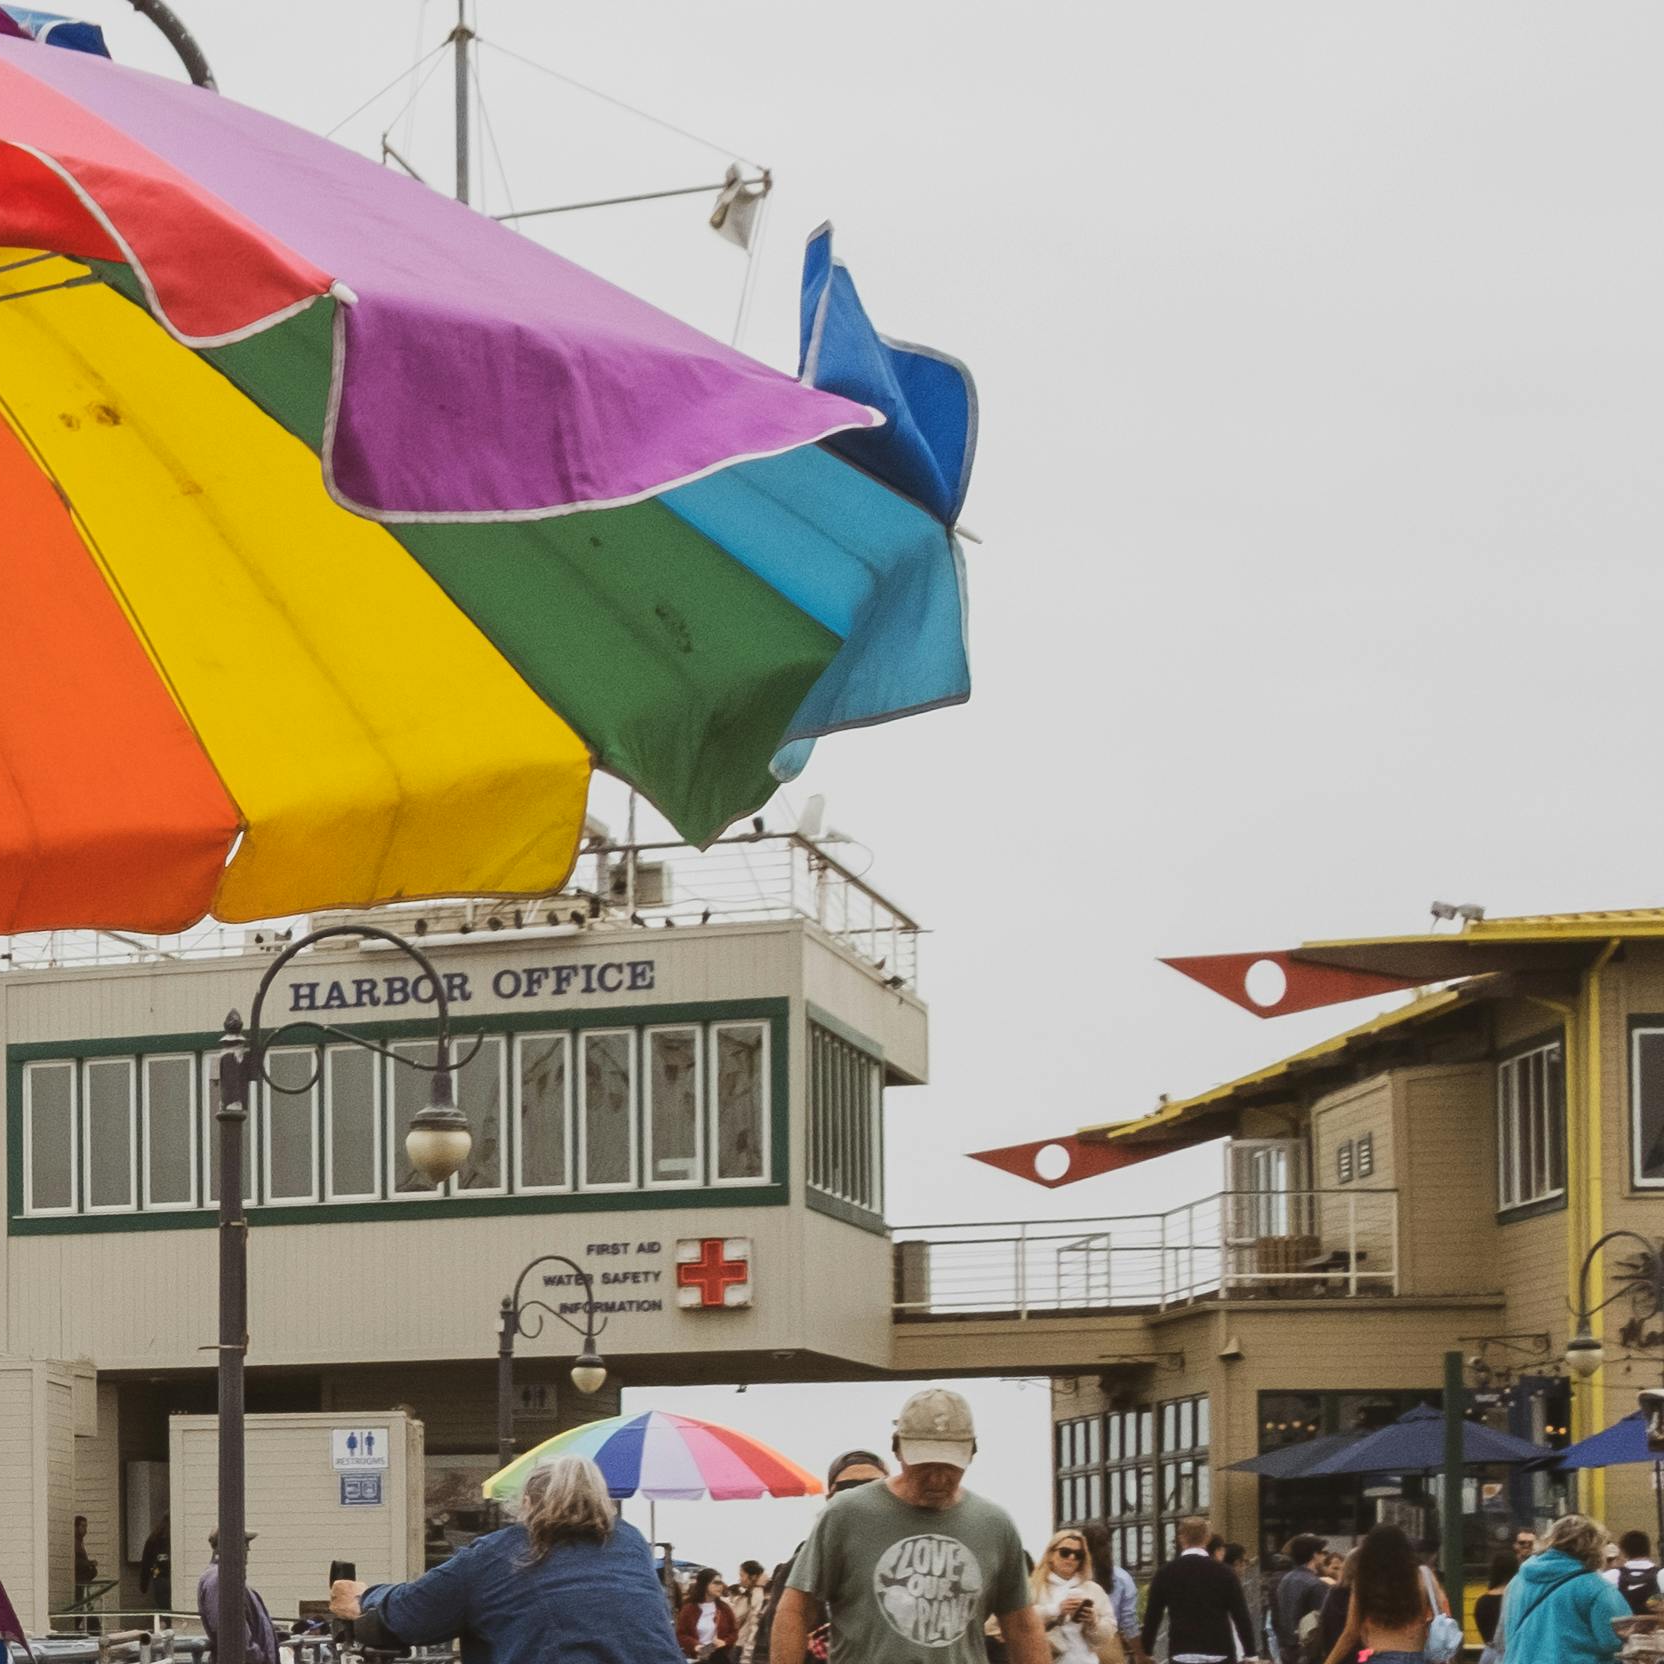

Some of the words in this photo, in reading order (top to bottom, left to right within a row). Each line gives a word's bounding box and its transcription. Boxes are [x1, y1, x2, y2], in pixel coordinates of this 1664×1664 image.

[289, 972, 472, 1012] HARBOR
[492, 960, 656, 999] OFFICE
[586, 1242, 630, 1256] FIRST
[636, 1241, 662, 1255] AID
[543, 1273, 594, 1287] WATER
[601, 1270, 662, 1286] SAFETY
[559, 1299, 663, 1315] INFORMATION
[895, 1539, 962, 1581] LOVE
[908, 1574, 954, 1600] OUR
